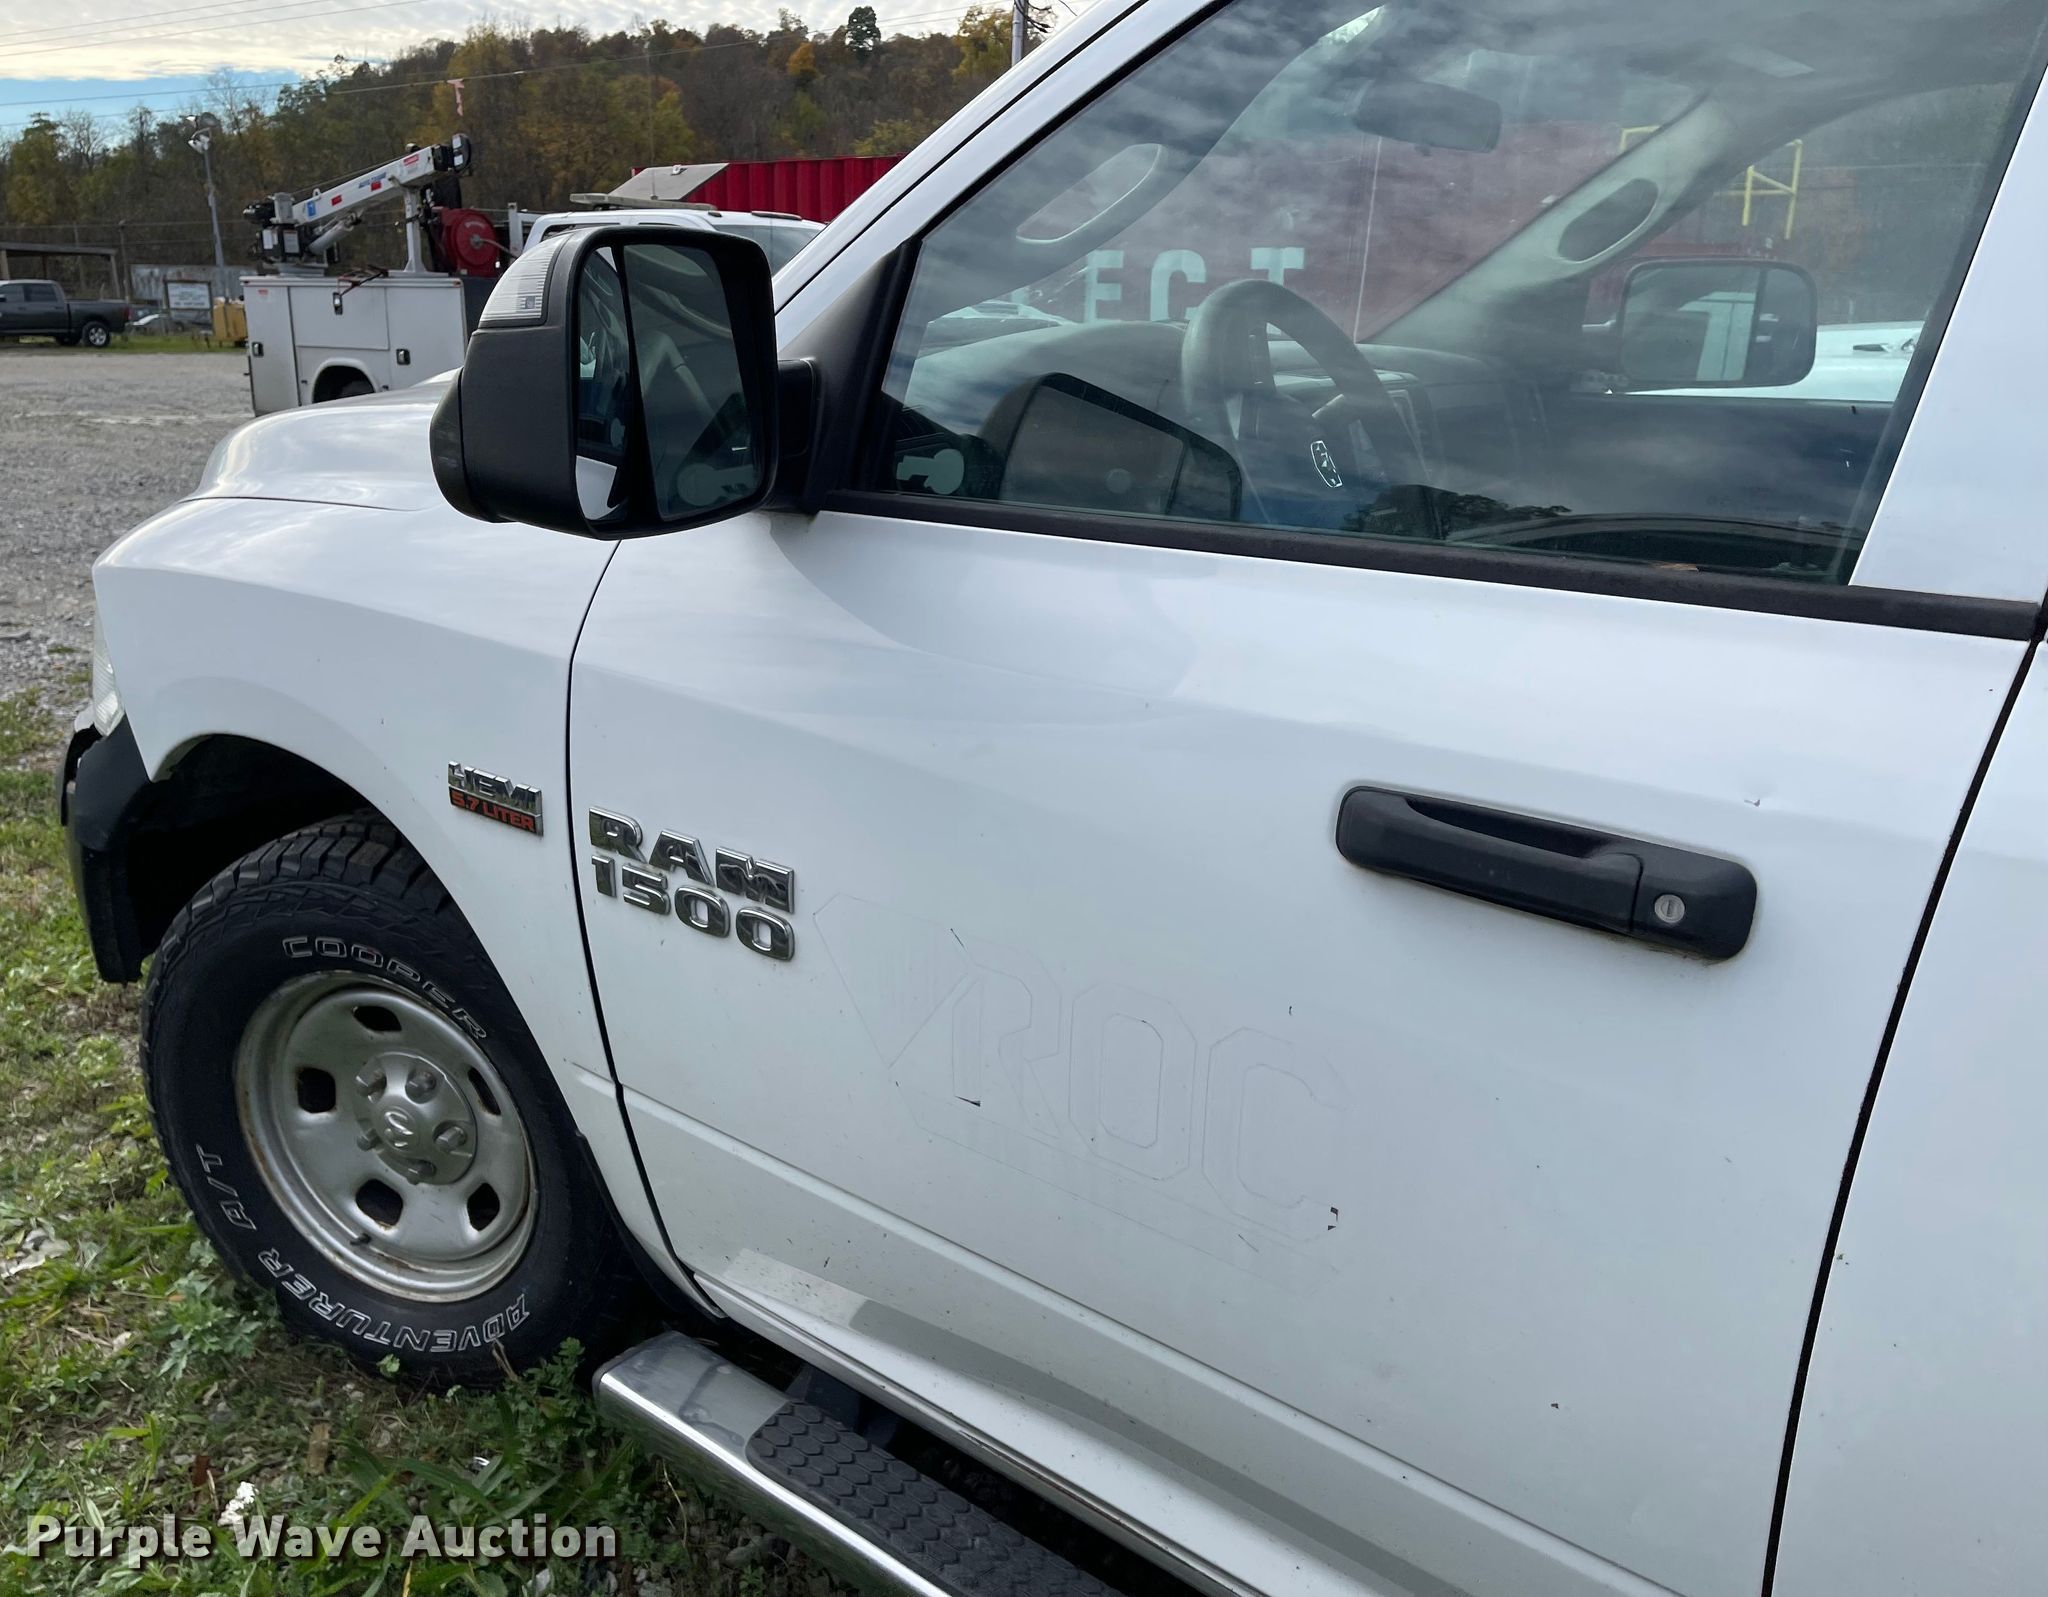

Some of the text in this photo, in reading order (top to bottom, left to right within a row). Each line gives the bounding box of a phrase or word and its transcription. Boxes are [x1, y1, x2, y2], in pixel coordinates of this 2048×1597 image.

[448, 760, 542, 813] HEMI
[451, 789, 535, 832] 5.7 LITER
[589, 806, 795, 913] RAM
[591, 854, 795, 961] 1500
[282, 935, 488, 1041] COOPER
[256, 1247, 531, 1354] ADVENTURER
